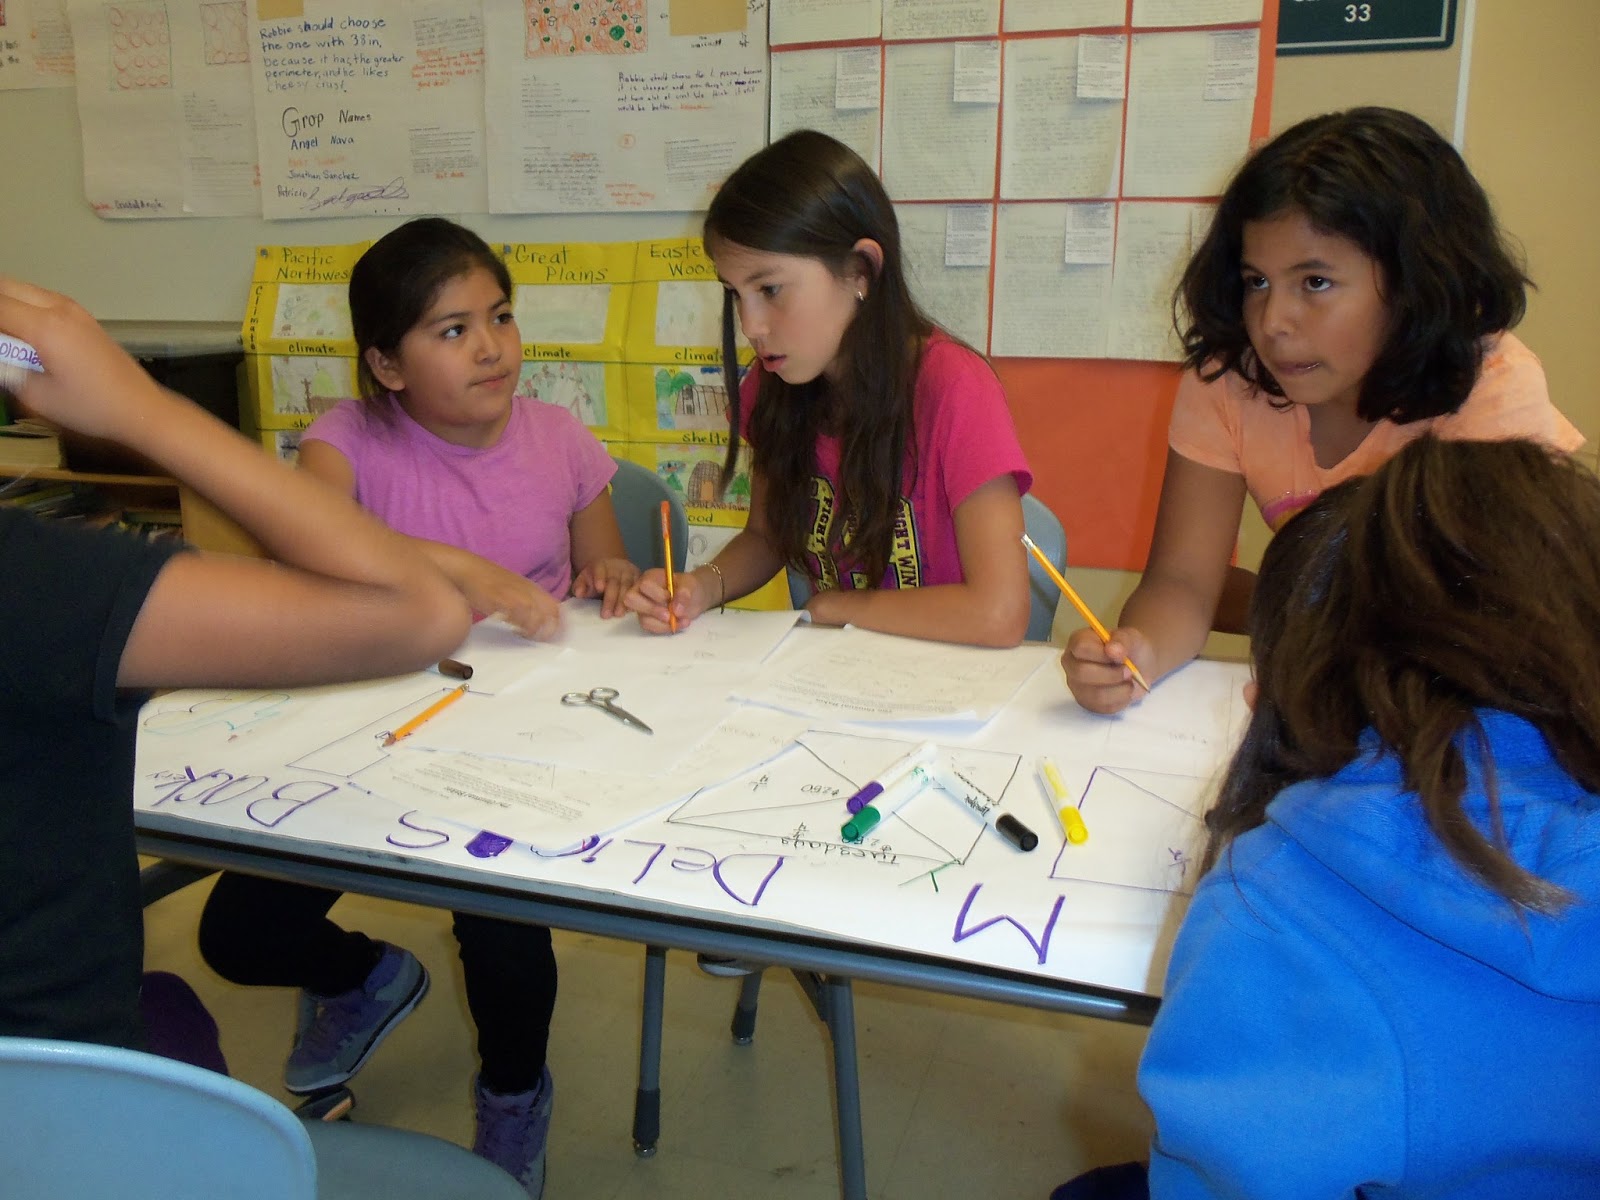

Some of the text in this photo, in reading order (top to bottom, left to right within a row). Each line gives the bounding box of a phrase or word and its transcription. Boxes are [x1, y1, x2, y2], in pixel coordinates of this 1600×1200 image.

[1344, 4, 1371, 23] 33
[299, 17, 333, 32] should
[340, 16, 386, 29] choose
[262, 42, 282, 53] the
[287, 41, 310, 49] one
[316, 34, 345, 48] with
[263, 56, 315, 67] because
[320, 55, 329, 64] it
[354, 54, 371, 64] the
[373, 54, 404, 67] greater
[363, 67, 389, 77] likes
[281, 107, 371, 137] Grop Names
[290, 135, 354, 150] Angel Nava
[322, 169, 360, 180] Sanchez
[282, 246, 334, 265] Pacific
[515, 244, 571, 265] Great
[276, 266, 350, 281] Northwes
[545, 266, 608, 284] Plains
[288, 343, 336, 354] climate
[523, 345, 572, 358] climate
[674, 347, 724, 361] climat
[682, 431, 729, 445] shelte
[897, 554, 917, 588] WIN
